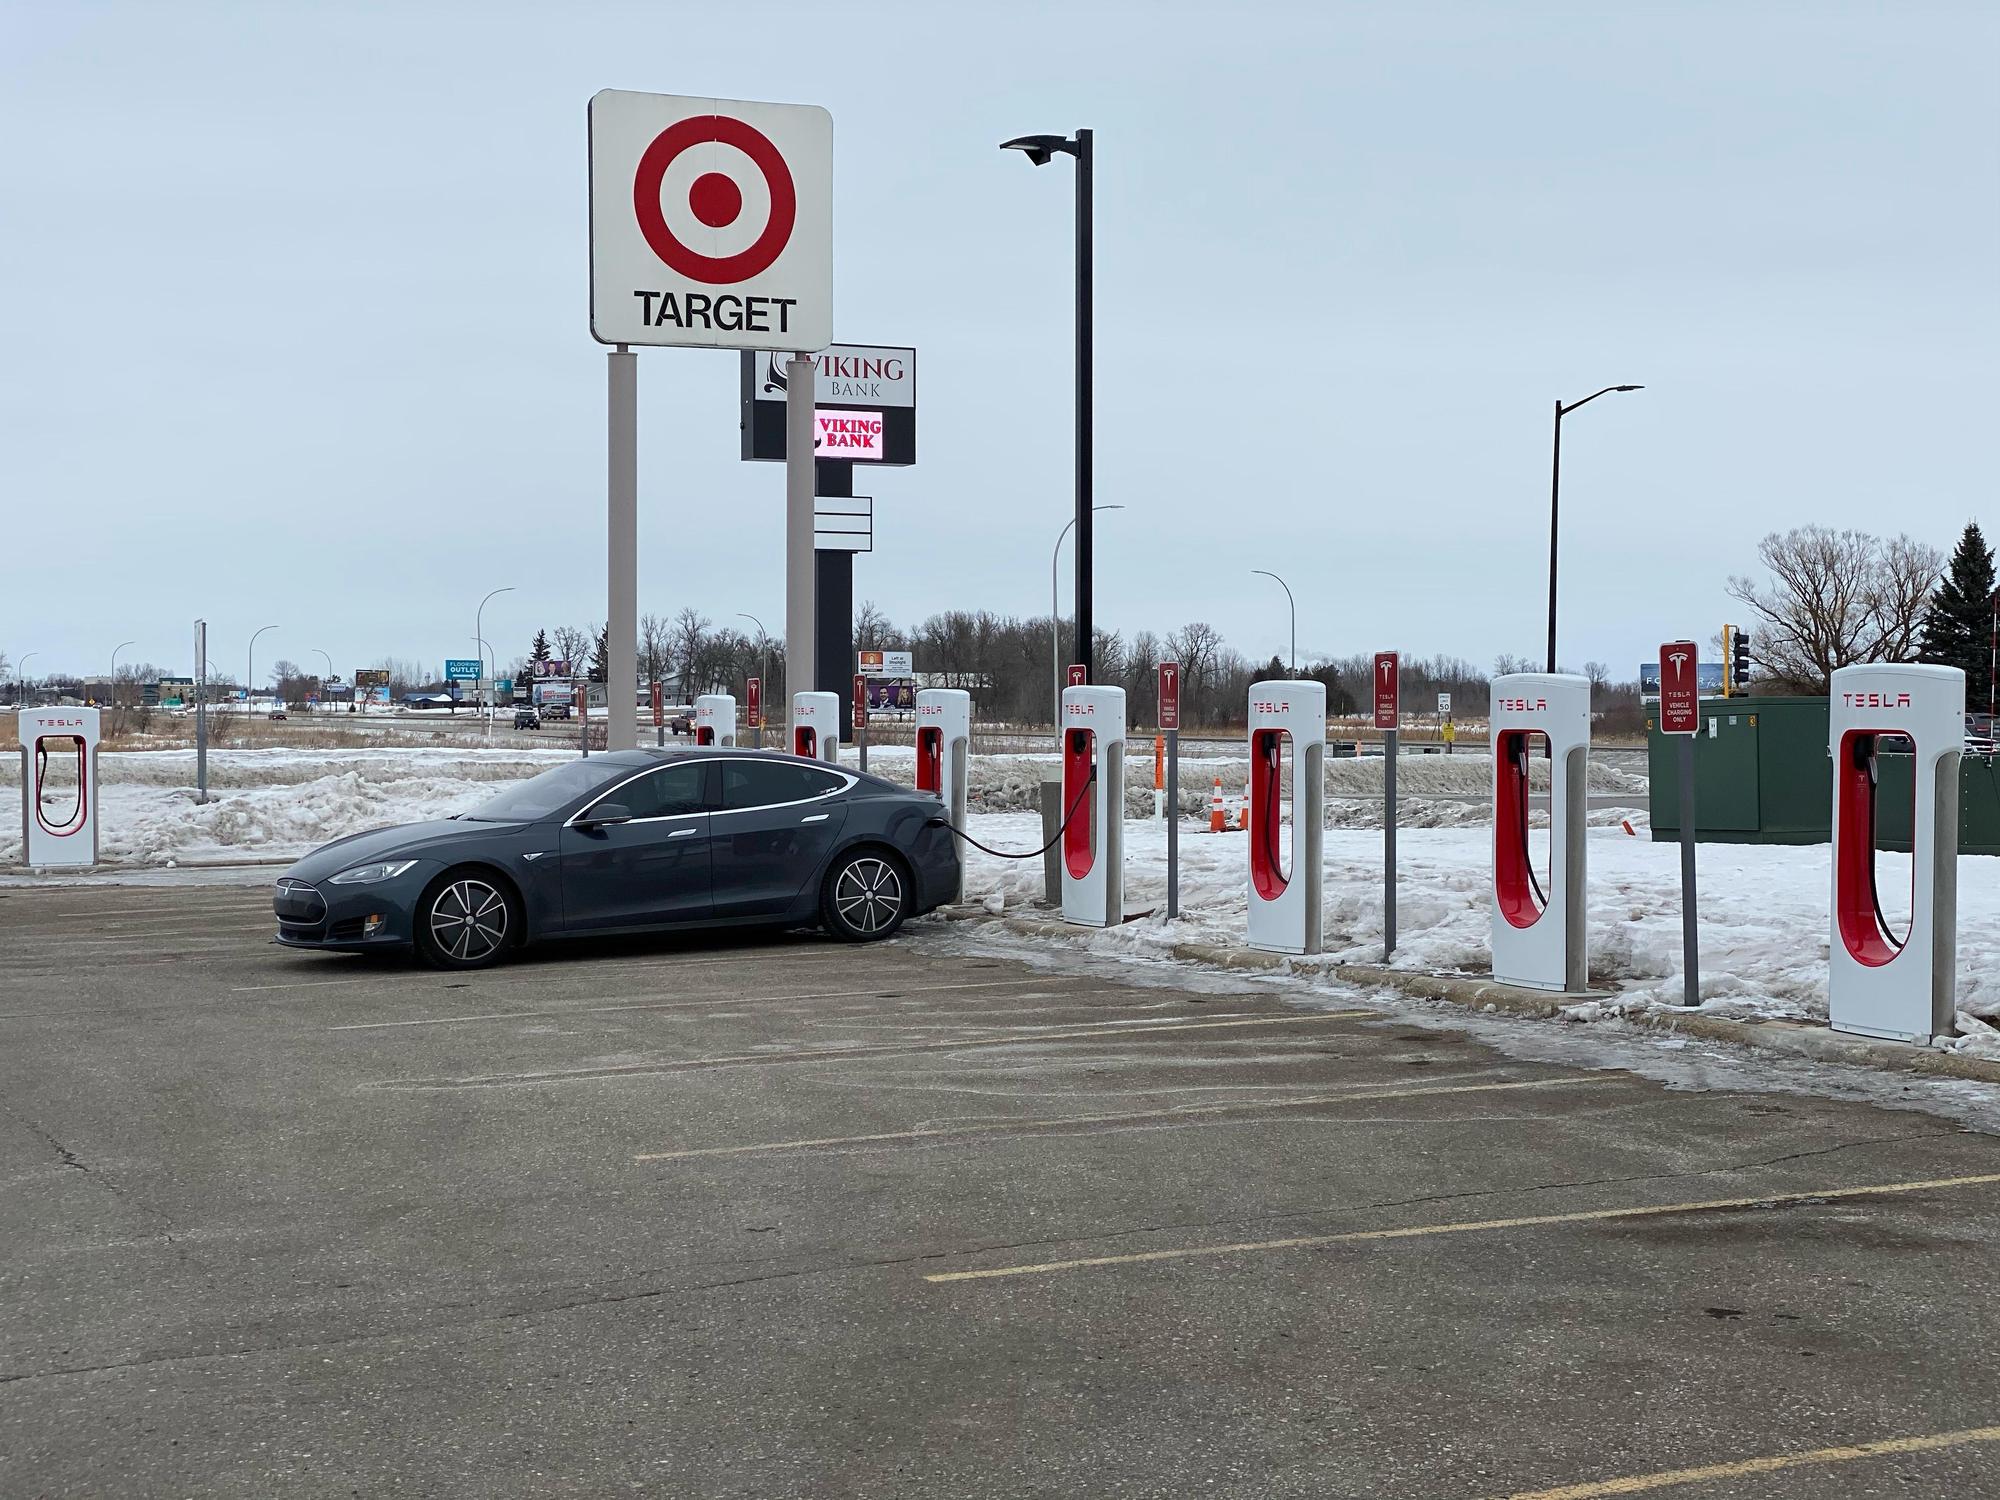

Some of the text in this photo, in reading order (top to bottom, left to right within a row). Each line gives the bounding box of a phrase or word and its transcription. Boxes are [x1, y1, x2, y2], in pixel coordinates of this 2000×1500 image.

[634, 290, 797, 332] TARGET
[832, 381, 881, 397] BANK
[819, 418, 882, 434] VIKING
[826, 433, 875, 448] BANK
[1498, 699, 1546, 711] TESLA
[1843, 693, 1910, 708] TESLA
[699, 708, 714, 716] ESLA
[918, 706, 942, 714] TESLA
[1065, 704, 1094, 714] TESLA
[1253, 702, 1289, 713] TESLA
[37, 719, 83, 727] TESLA
